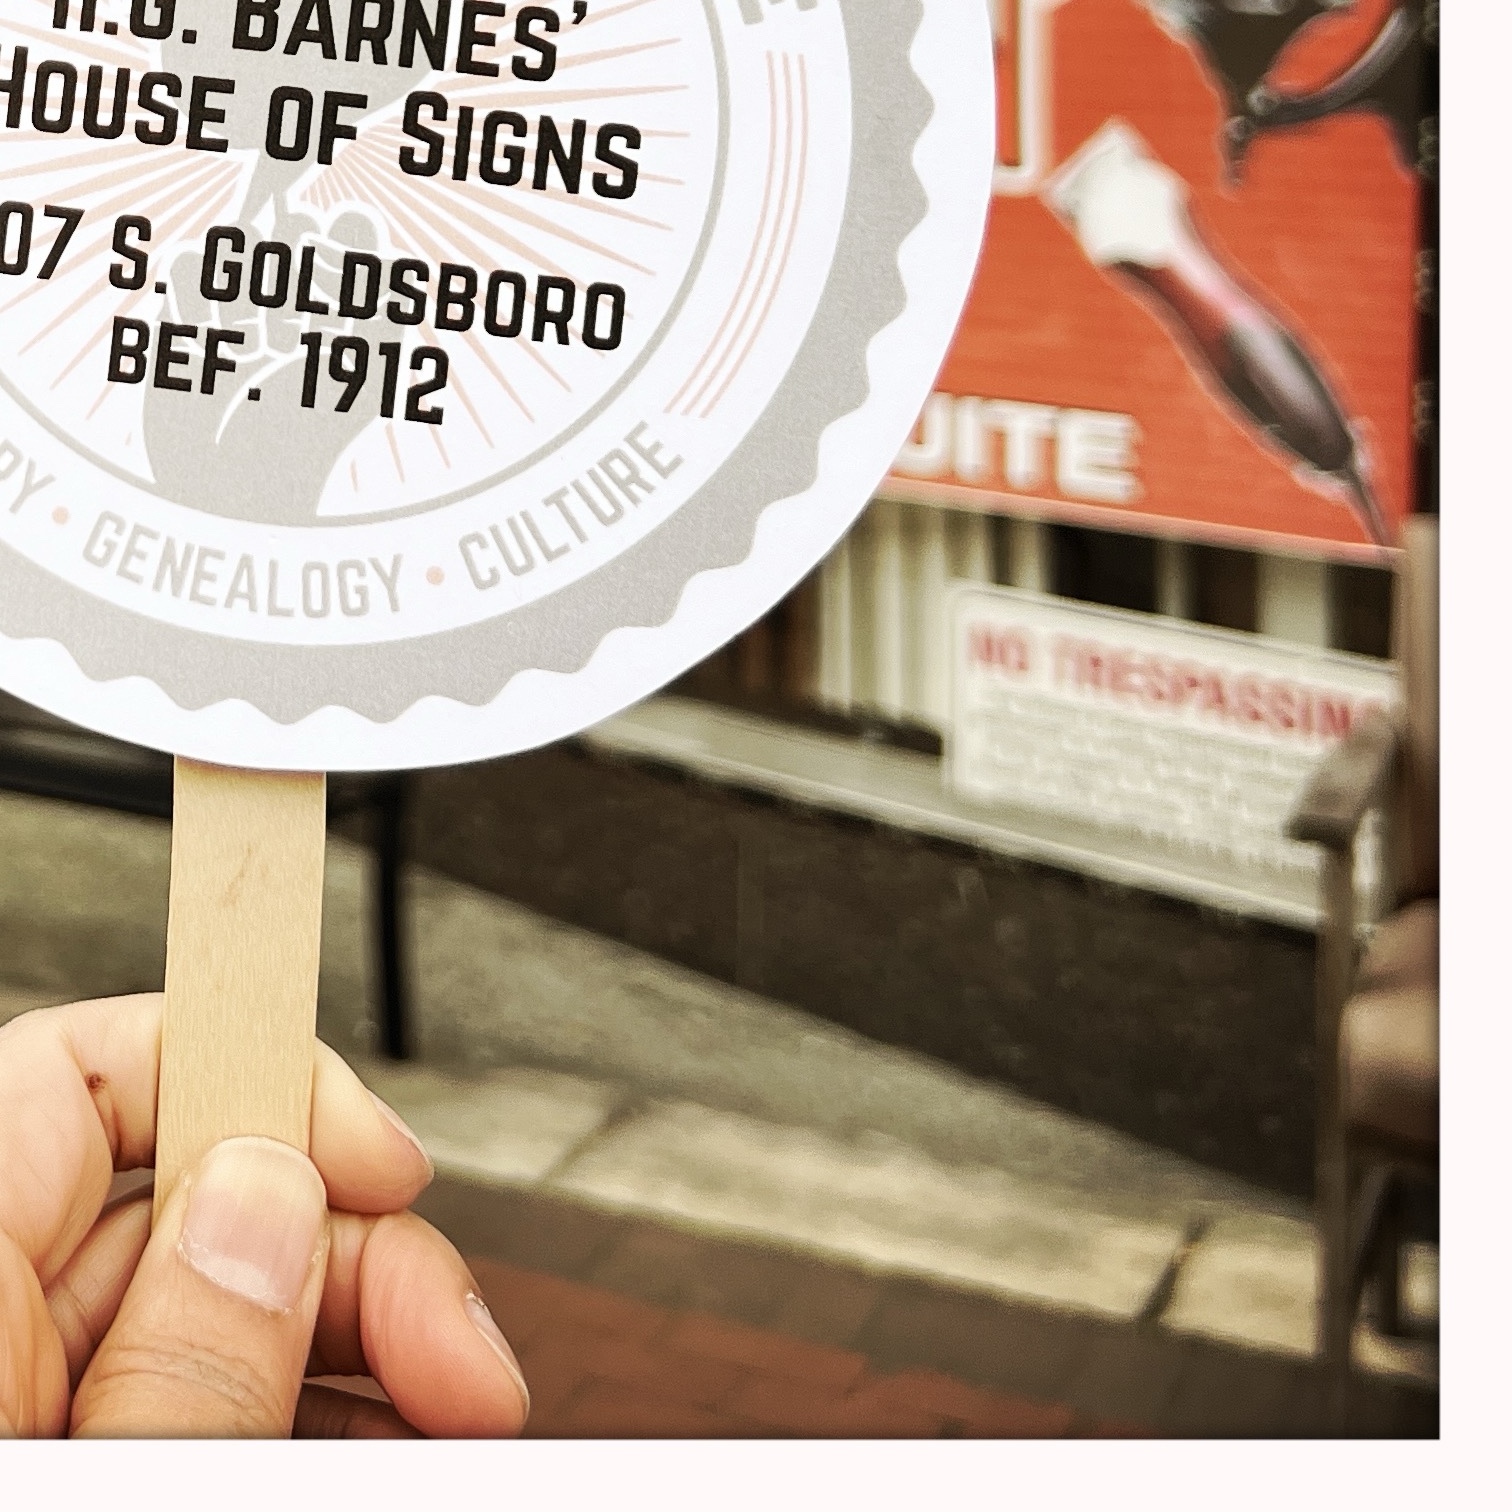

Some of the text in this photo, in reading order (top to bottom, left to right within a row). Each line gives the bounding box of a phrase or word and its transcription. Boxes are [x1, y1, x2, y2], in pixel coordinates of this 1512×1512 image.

[265, 85, 370, 167] OF
[397, 90, 643, 200] SIGNS
[108, 214, 169, 295] S.
[198, 224, 627, 352] GOLDSBORO
[106, 315, 450, 427] BEF. 1912
[890, 390, 1144, 505] UITE
[82, 510, 404, 619] GENEALOGY
[458, 420, 685, 591] CULTURE
[968, 621, 1030, 674] NO
